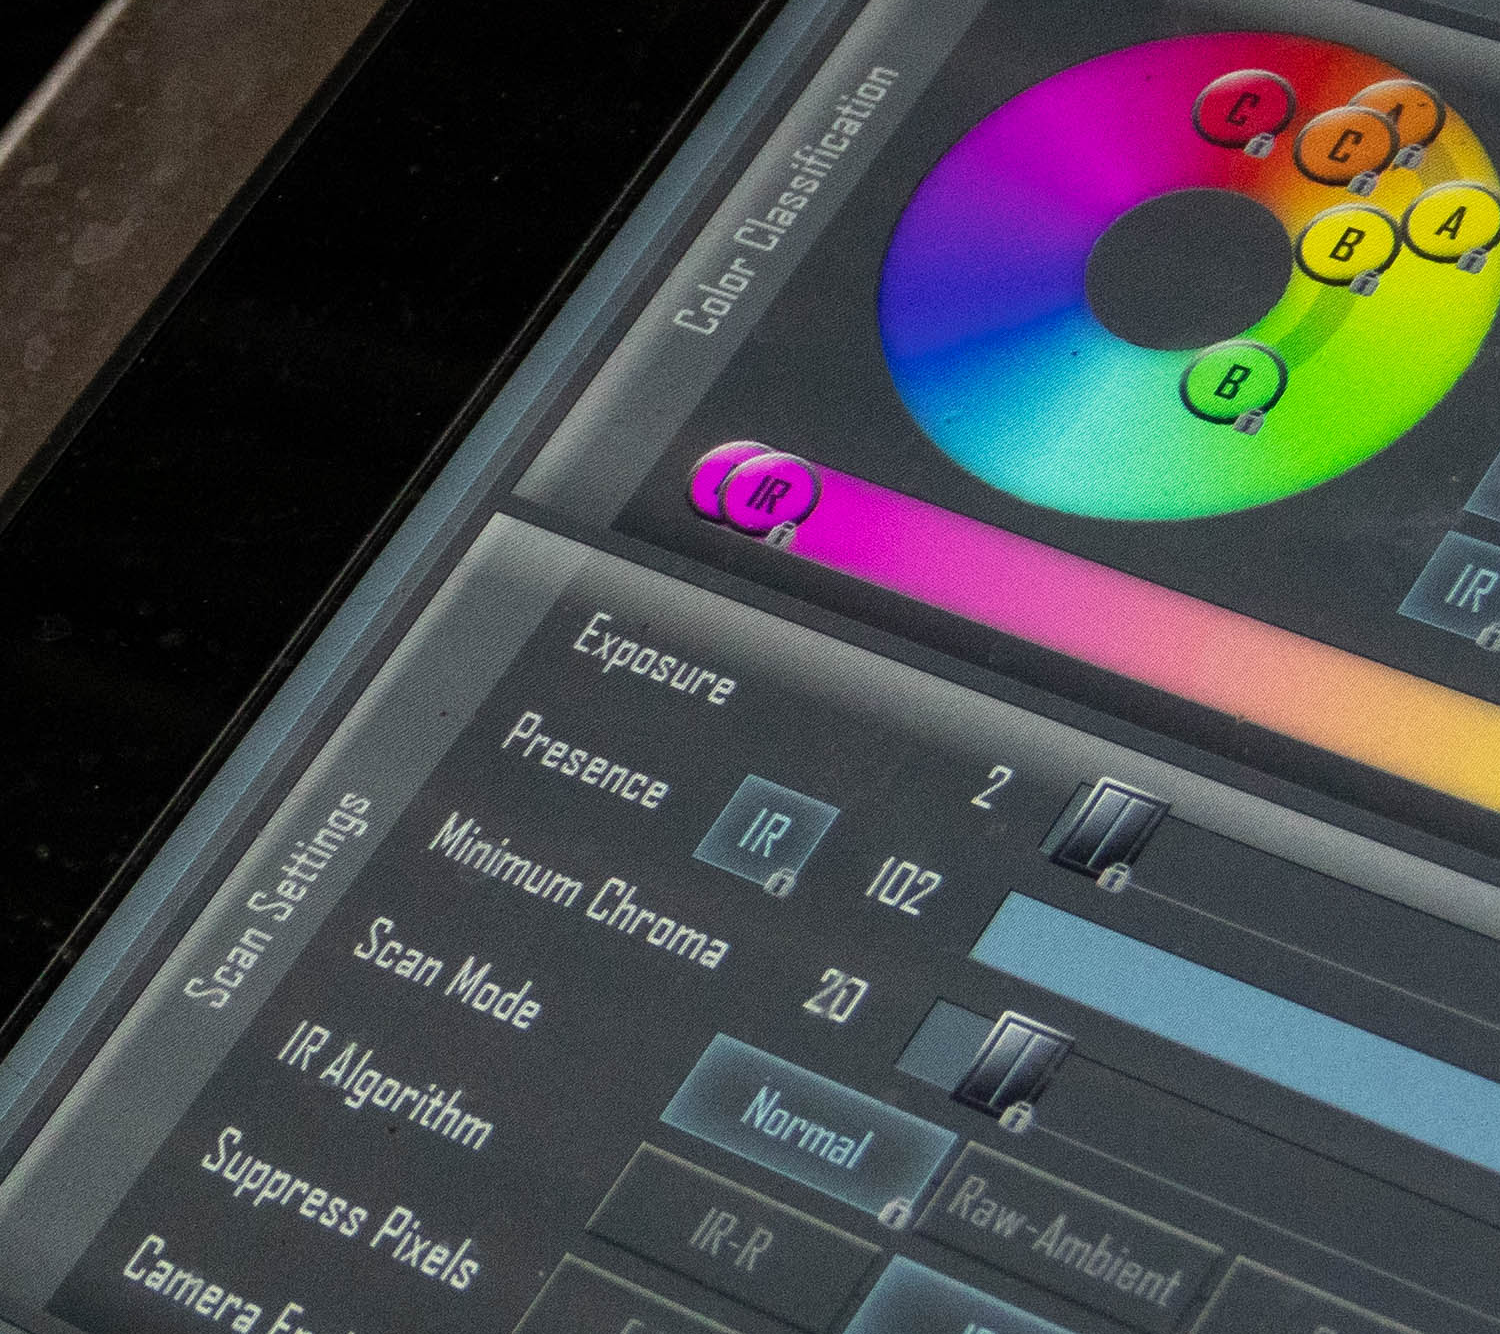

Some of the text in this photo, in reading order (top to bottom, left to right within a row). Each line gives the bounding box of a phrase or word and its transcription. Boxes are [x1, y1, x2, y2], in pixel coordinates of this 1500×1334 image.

[1225, 92, 1261, 127] C
[1327, 130, 1363, 163] C
[674, 63, 900, 339] Color Classification
[1329, 226, 1365, 262] B
[1434, 205, 1467, 240] A
[1214, 364, 1254, 400] B
[746, 475, 793, 515] IR
[1445, 564, 1499, 613] IR
[572, 612, 1014, 809] Exposure 2
[500, 712, 944, 916] Presence IR 102
[185, 790, 372, 1010] Scan Settings
[427, 810, 870, 1024] Minimum Chroma 20
[278, 1020, 322, 1072] IR
[320, 1042, 495, 1152] Algorithm
[689, 1207, 775, 1273] IR-R
[353, 917, 443, 989] Scan
[447, 955, 543, 1032] Mode
[739, 1085, 872, 1171] Normal
[944, 1175, 1183, 1310] Raw-Ambient
[201, 1126, 369, 1238] Suppress
[370, 1206, 480, 1293] Pixels
